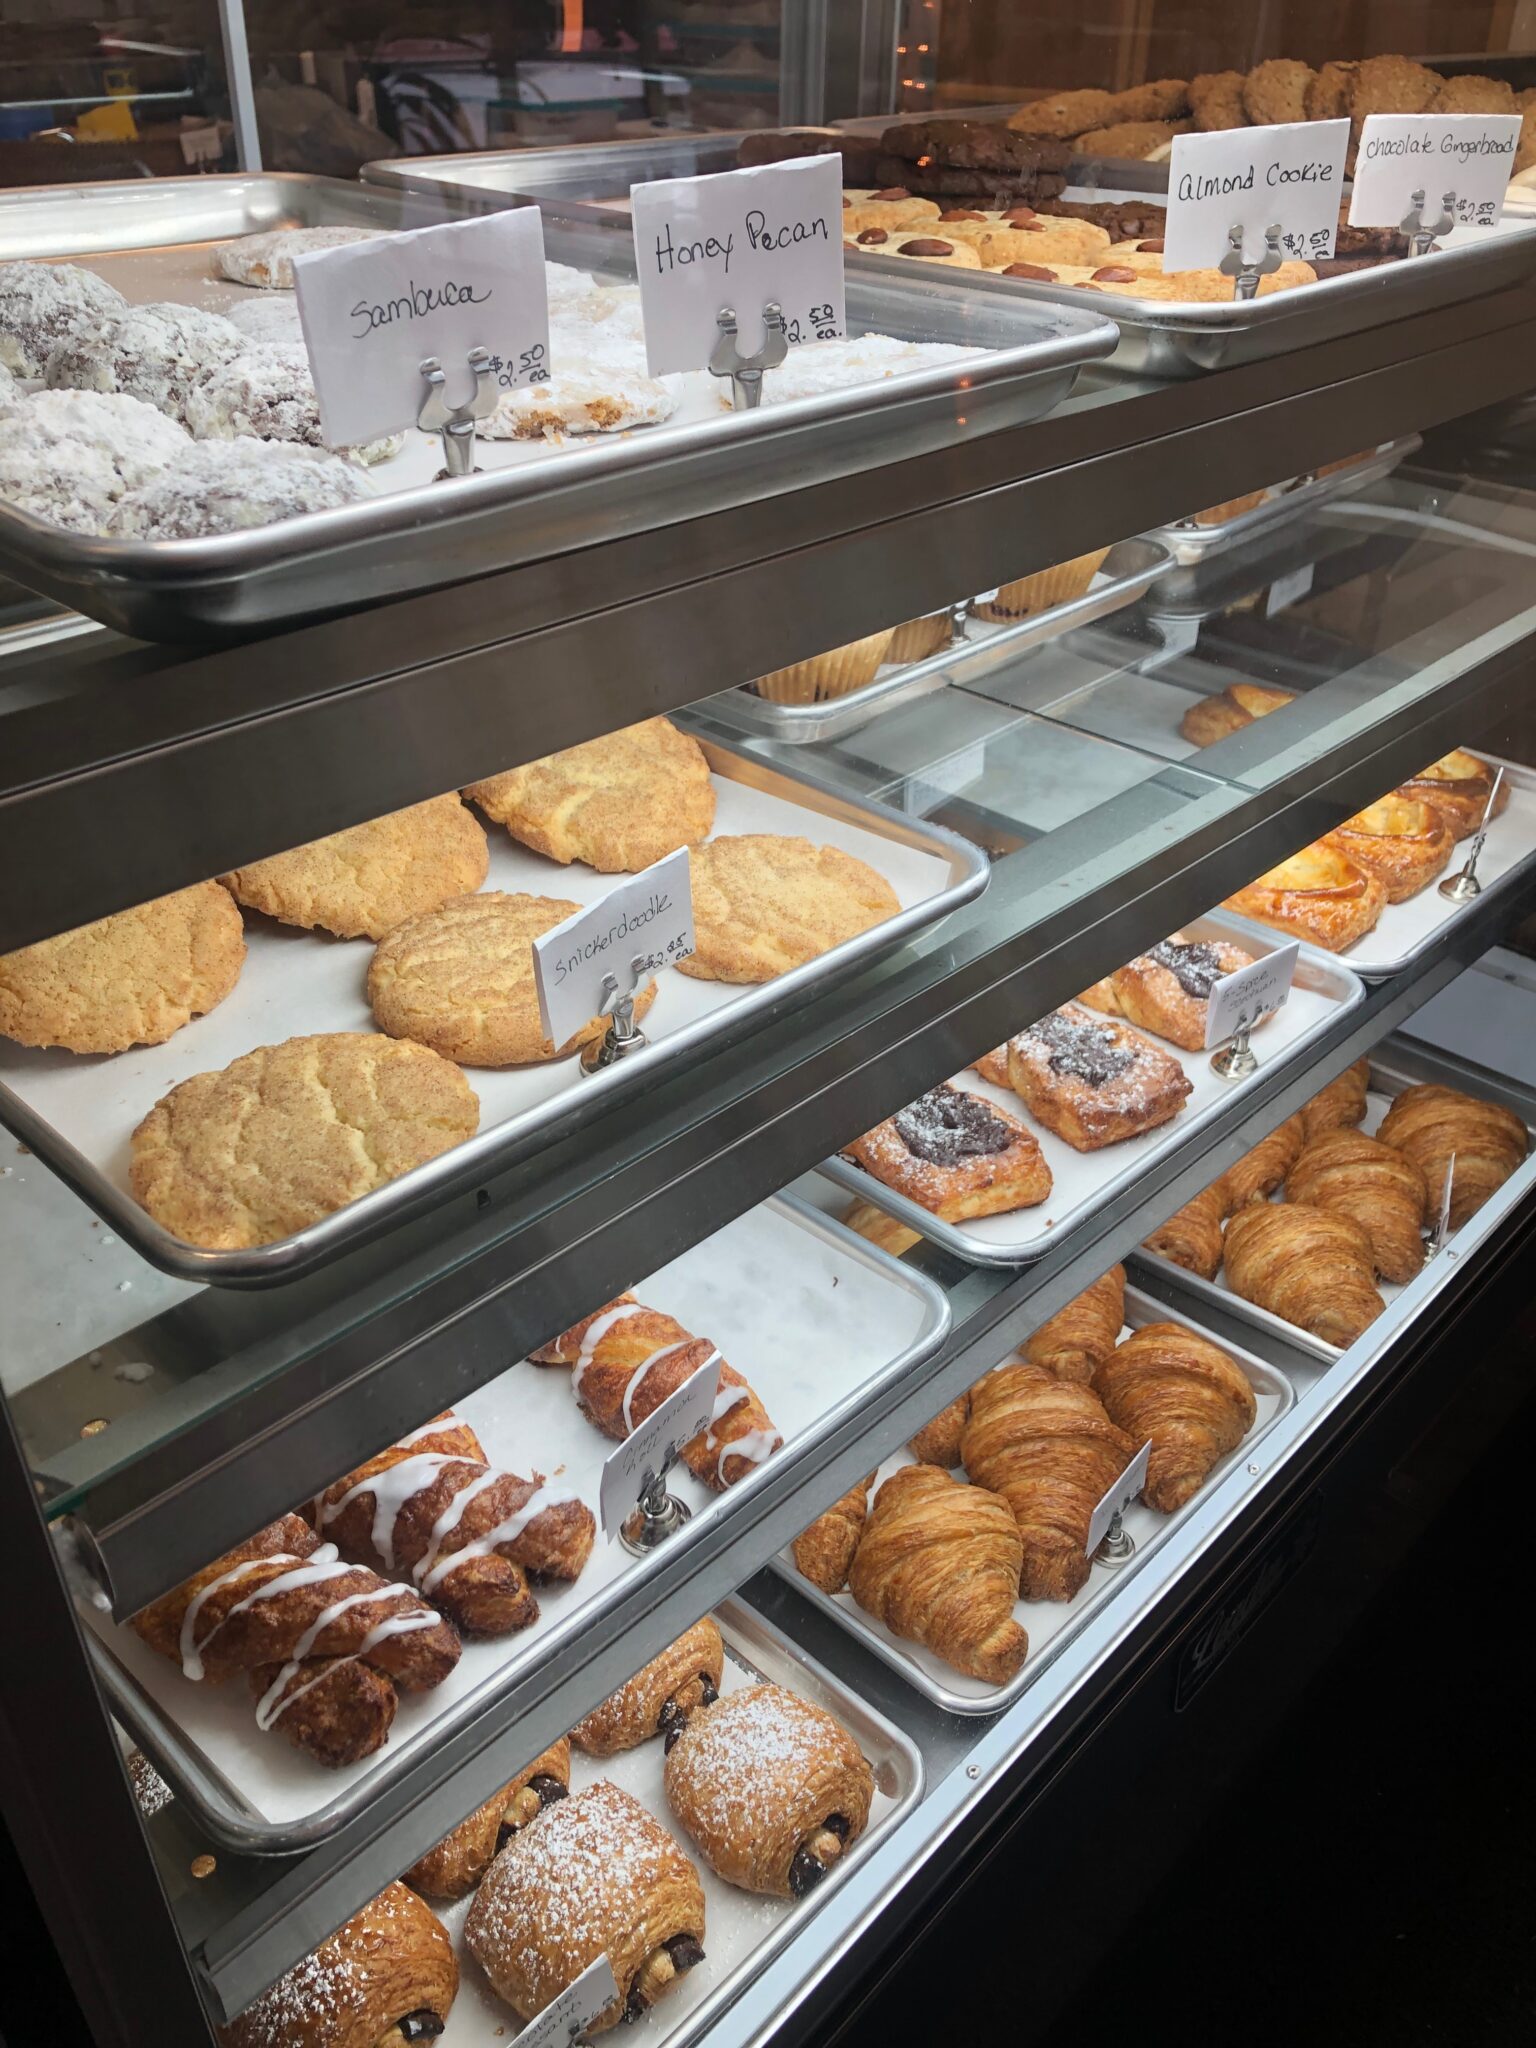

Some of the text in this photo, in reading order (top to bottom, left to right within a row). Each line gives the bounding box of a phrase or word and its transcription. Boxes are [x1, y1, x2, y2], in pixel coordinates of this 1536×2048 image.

[1266, 162, 1333, 187] Cookie
[656, 210, 829, 273] Honey Pecan
[350, 280, 493, 339] Sambuca
[554, 894, 673, 986] Snickerdoodle
